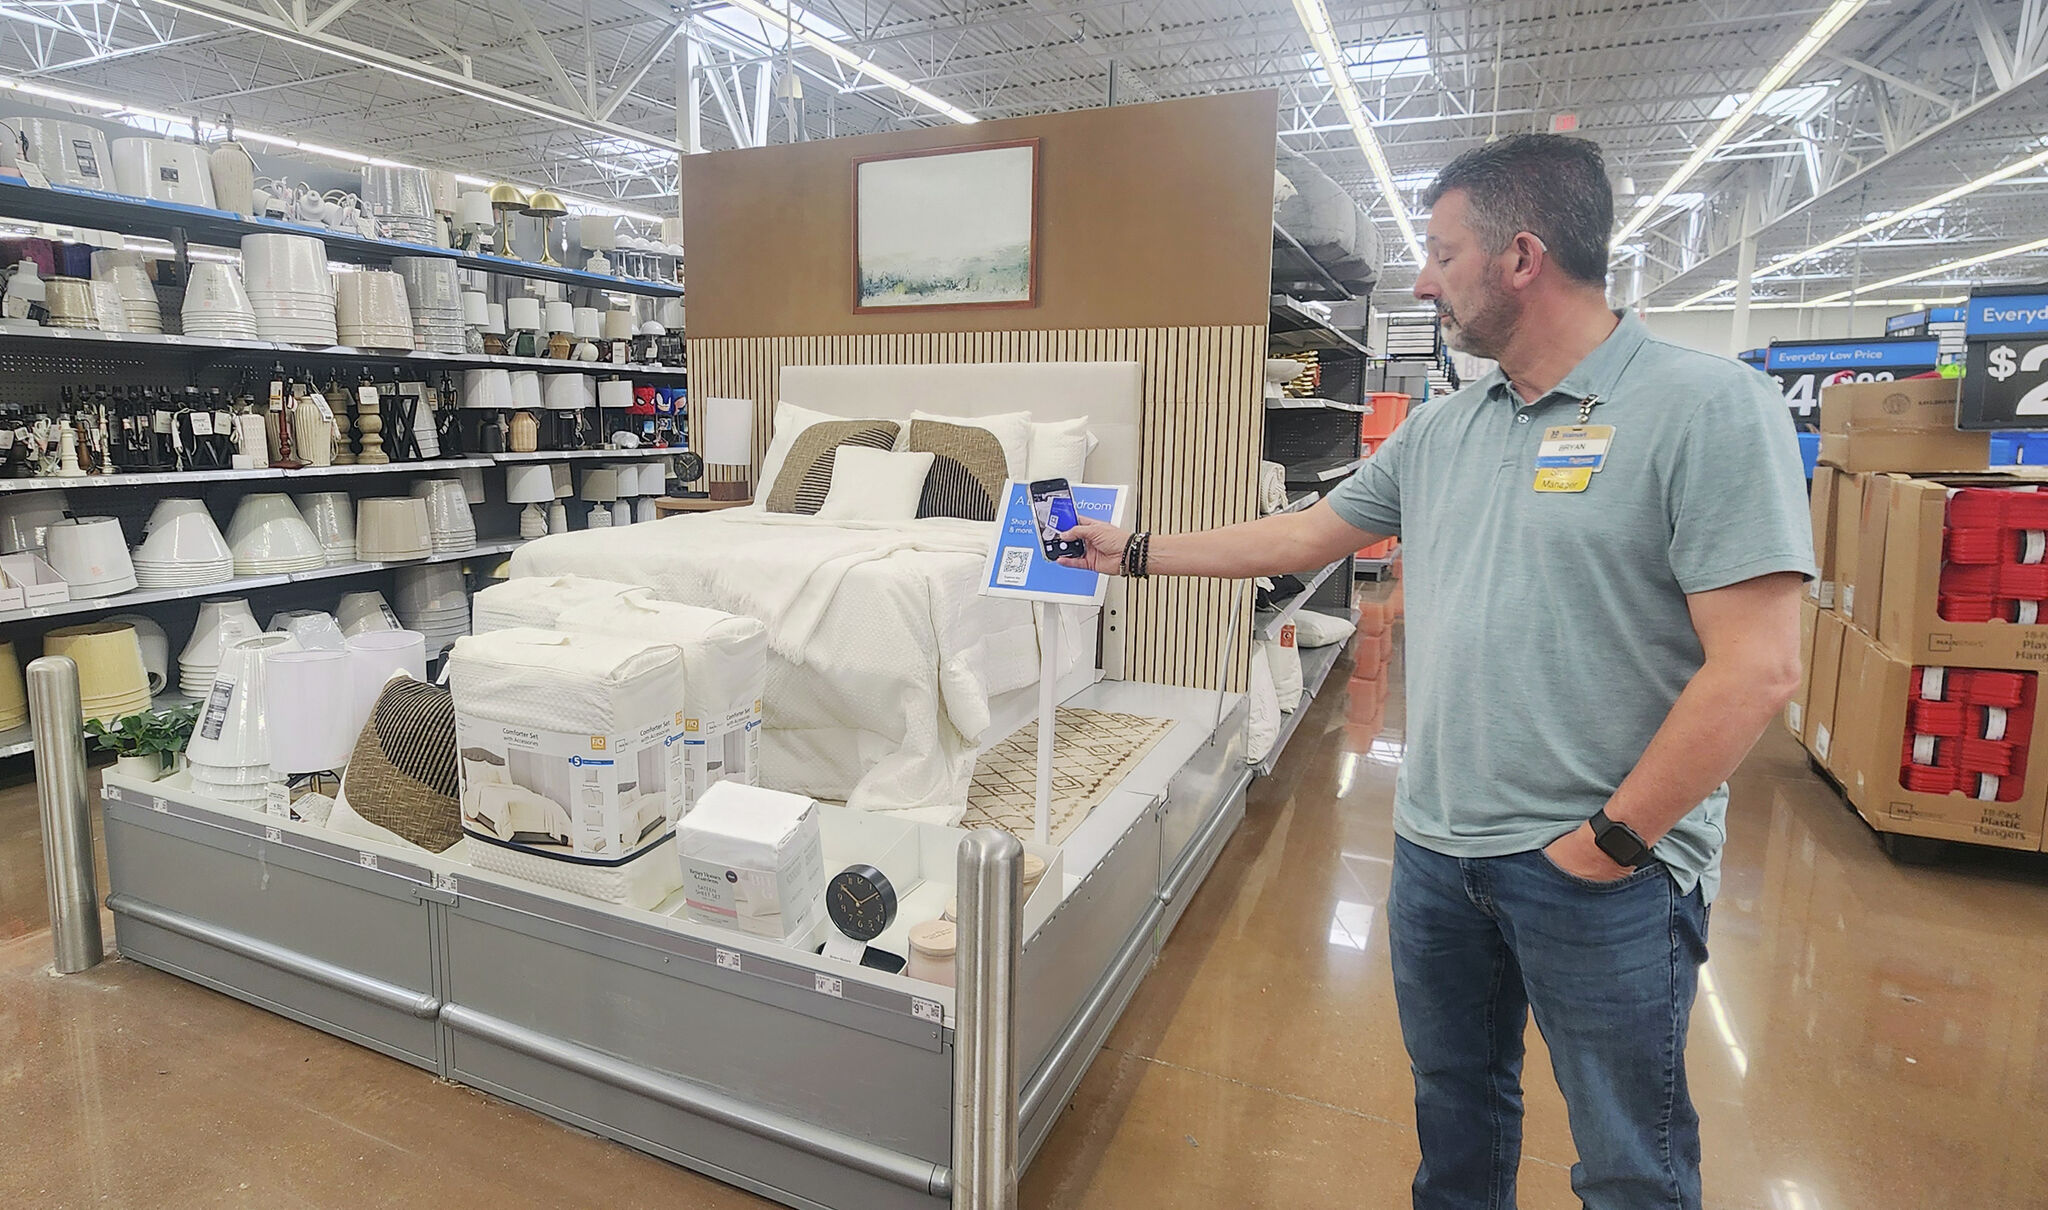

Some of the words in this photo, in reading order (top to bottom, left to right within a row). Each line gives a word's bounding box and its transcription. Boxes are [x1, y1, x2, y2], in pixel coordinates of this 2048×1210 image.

[1779, 351, 1827, 362] Everyday
[1829, 351, 1853, 361] Low
[1854, 349, 1883, 359] Price
[1015, 495, 1025, 506] A
[1076, 500, 1112, 511] droom
[1010, 518, 1026, 528] Shop
[1015, 526, 1034, 535] more.
[502, 727, 529, 738] Comforter
[529, 732, 540, 740] Set
[1981, 817, 2021, 829] Plastic
[1973, 825, 2026, 840] Hangers
